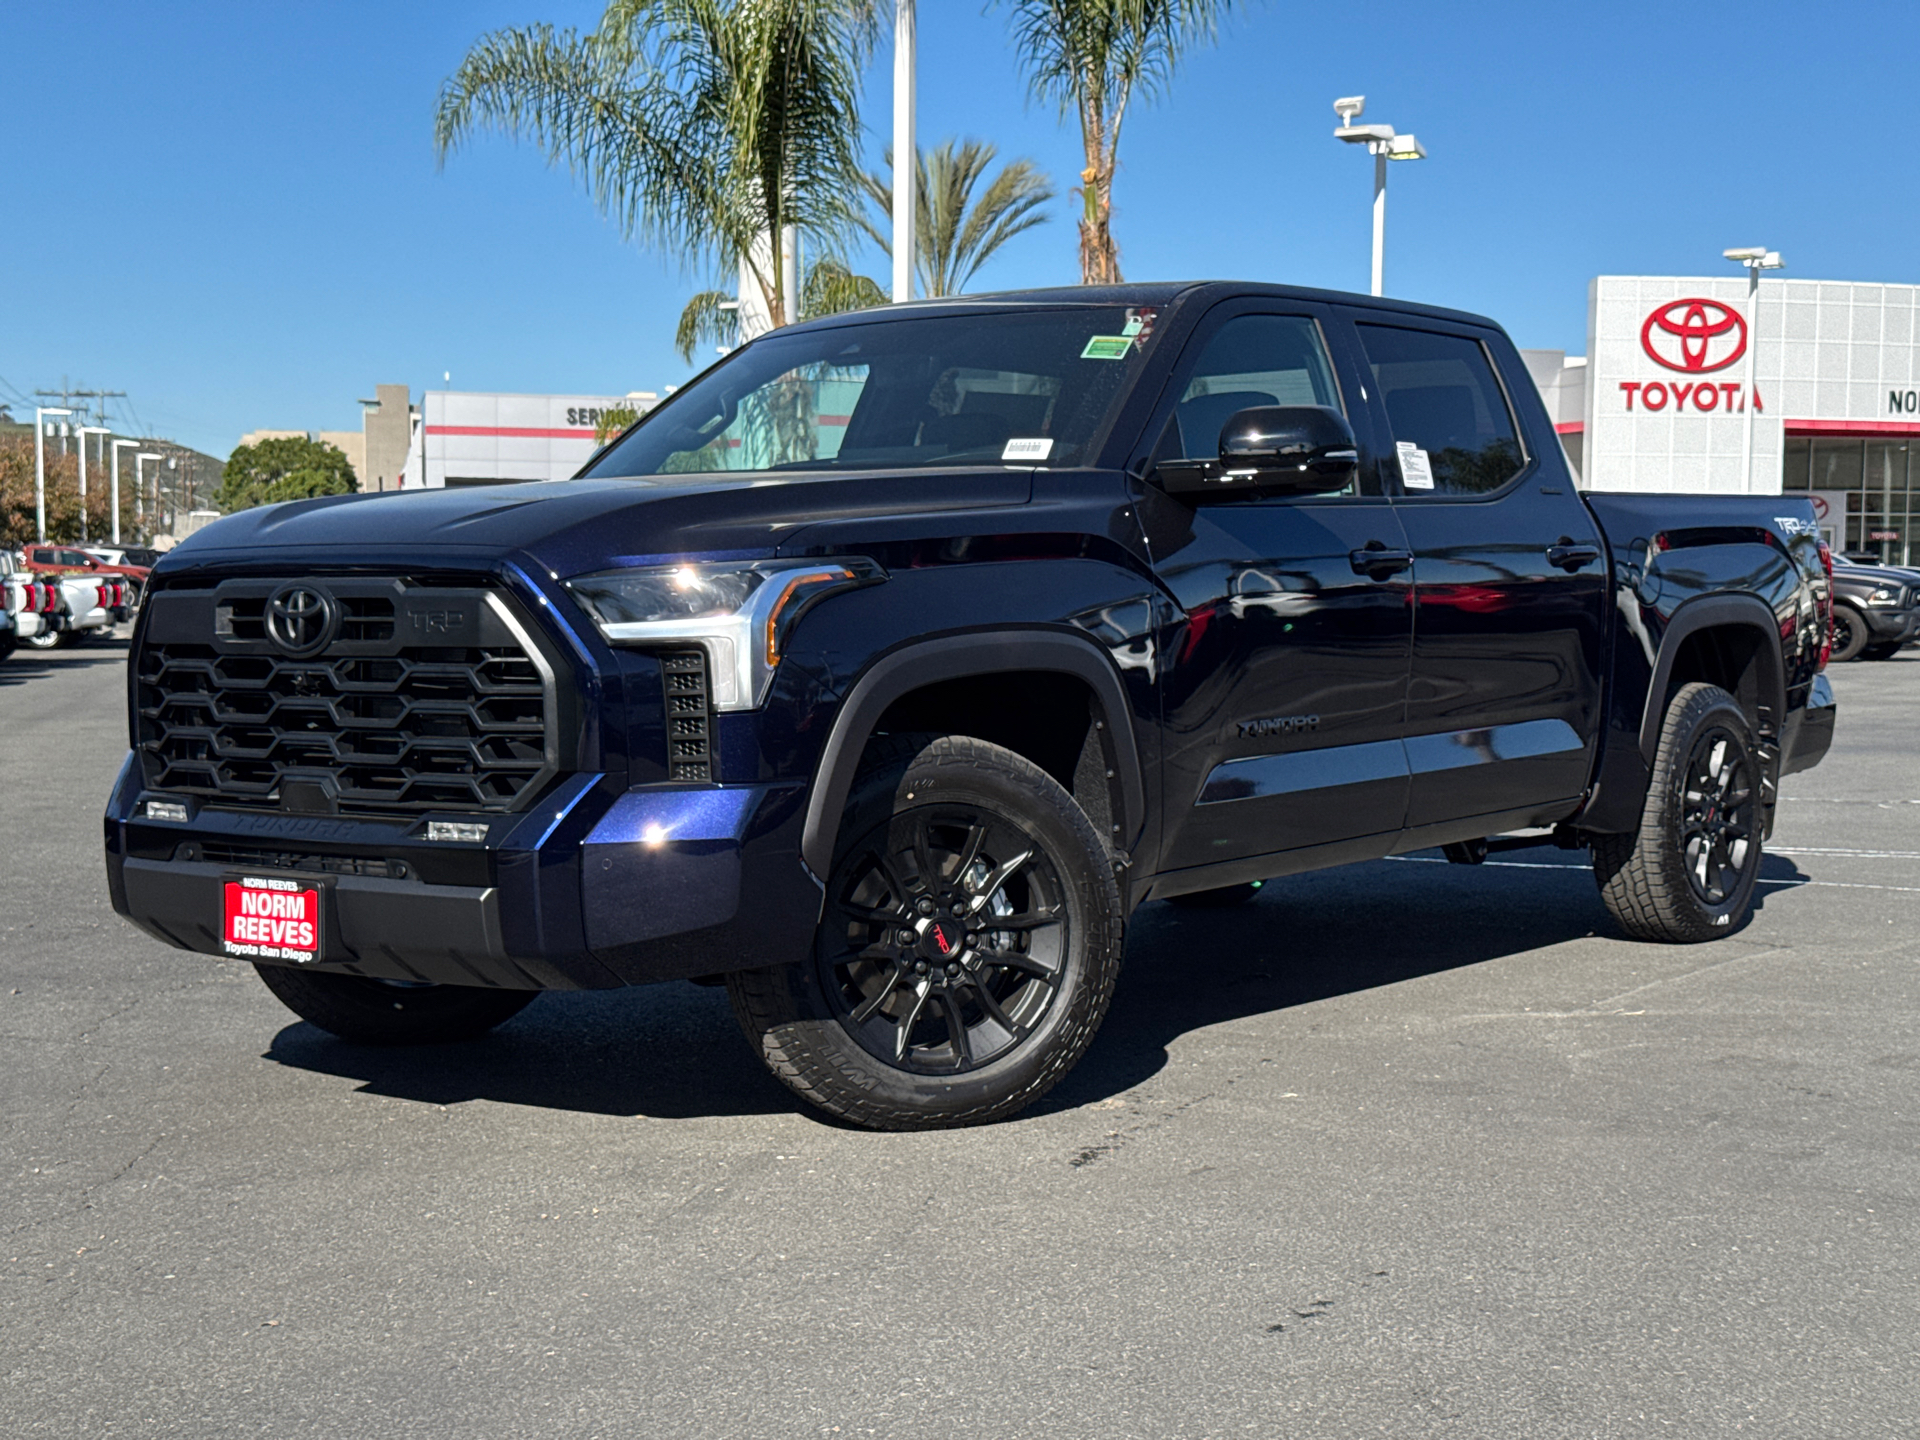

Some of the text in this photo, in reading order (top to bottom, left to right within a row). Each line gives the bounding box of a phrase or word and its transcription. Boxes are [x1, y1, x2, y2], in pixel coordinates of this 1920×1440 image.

[1619, 382, 1763, 413] TOYOTA
[1889, 390, 1920, 414] NO
[1773, 516, 1800, 535] TRD
[407, 610, 463, 633] TRD
[232, 814, 359, 838] TUNDRA
[243, 877, 298, 892] NORM REEVES
[241, 892, 305, 920] NORM
[233, 916, 313, 946] REEVES
[933, 923, 950, 954] TRD
[224, 940, 313, 963] Toyota San Diego
